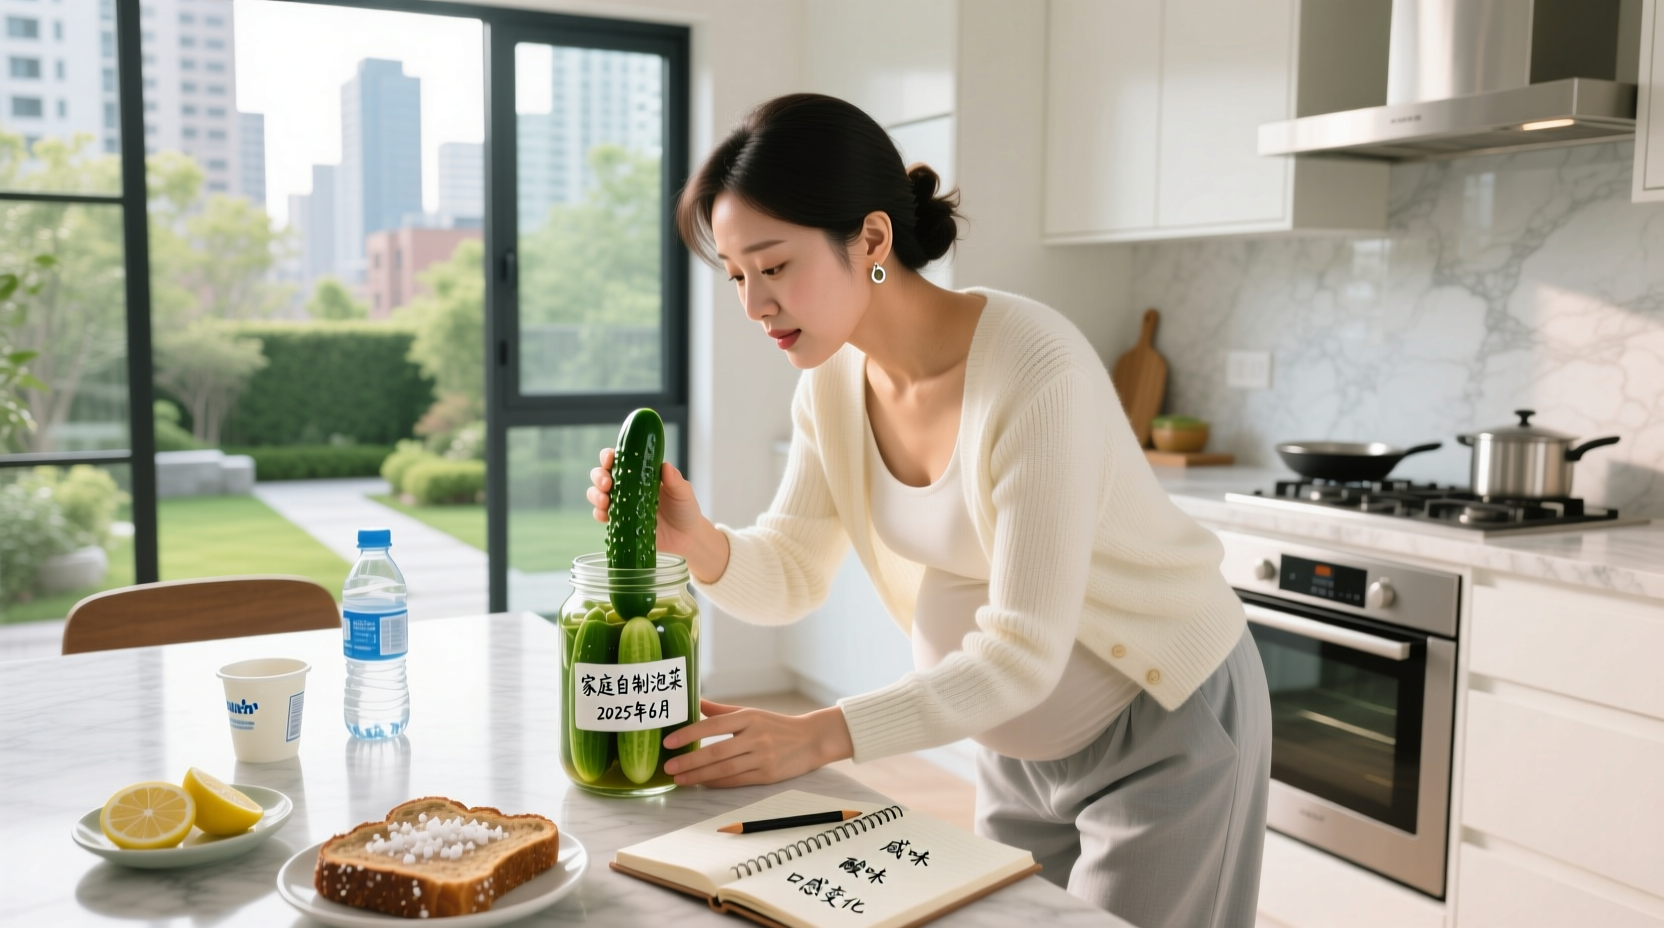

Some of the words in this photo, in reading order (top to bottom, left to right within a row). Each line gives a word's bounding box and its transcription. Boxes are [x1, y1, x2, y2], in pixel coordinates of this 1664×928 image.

[581, 666, 683, 697] 家庭自制泡菜
[596, 699, 669, 723] 2025年6月
